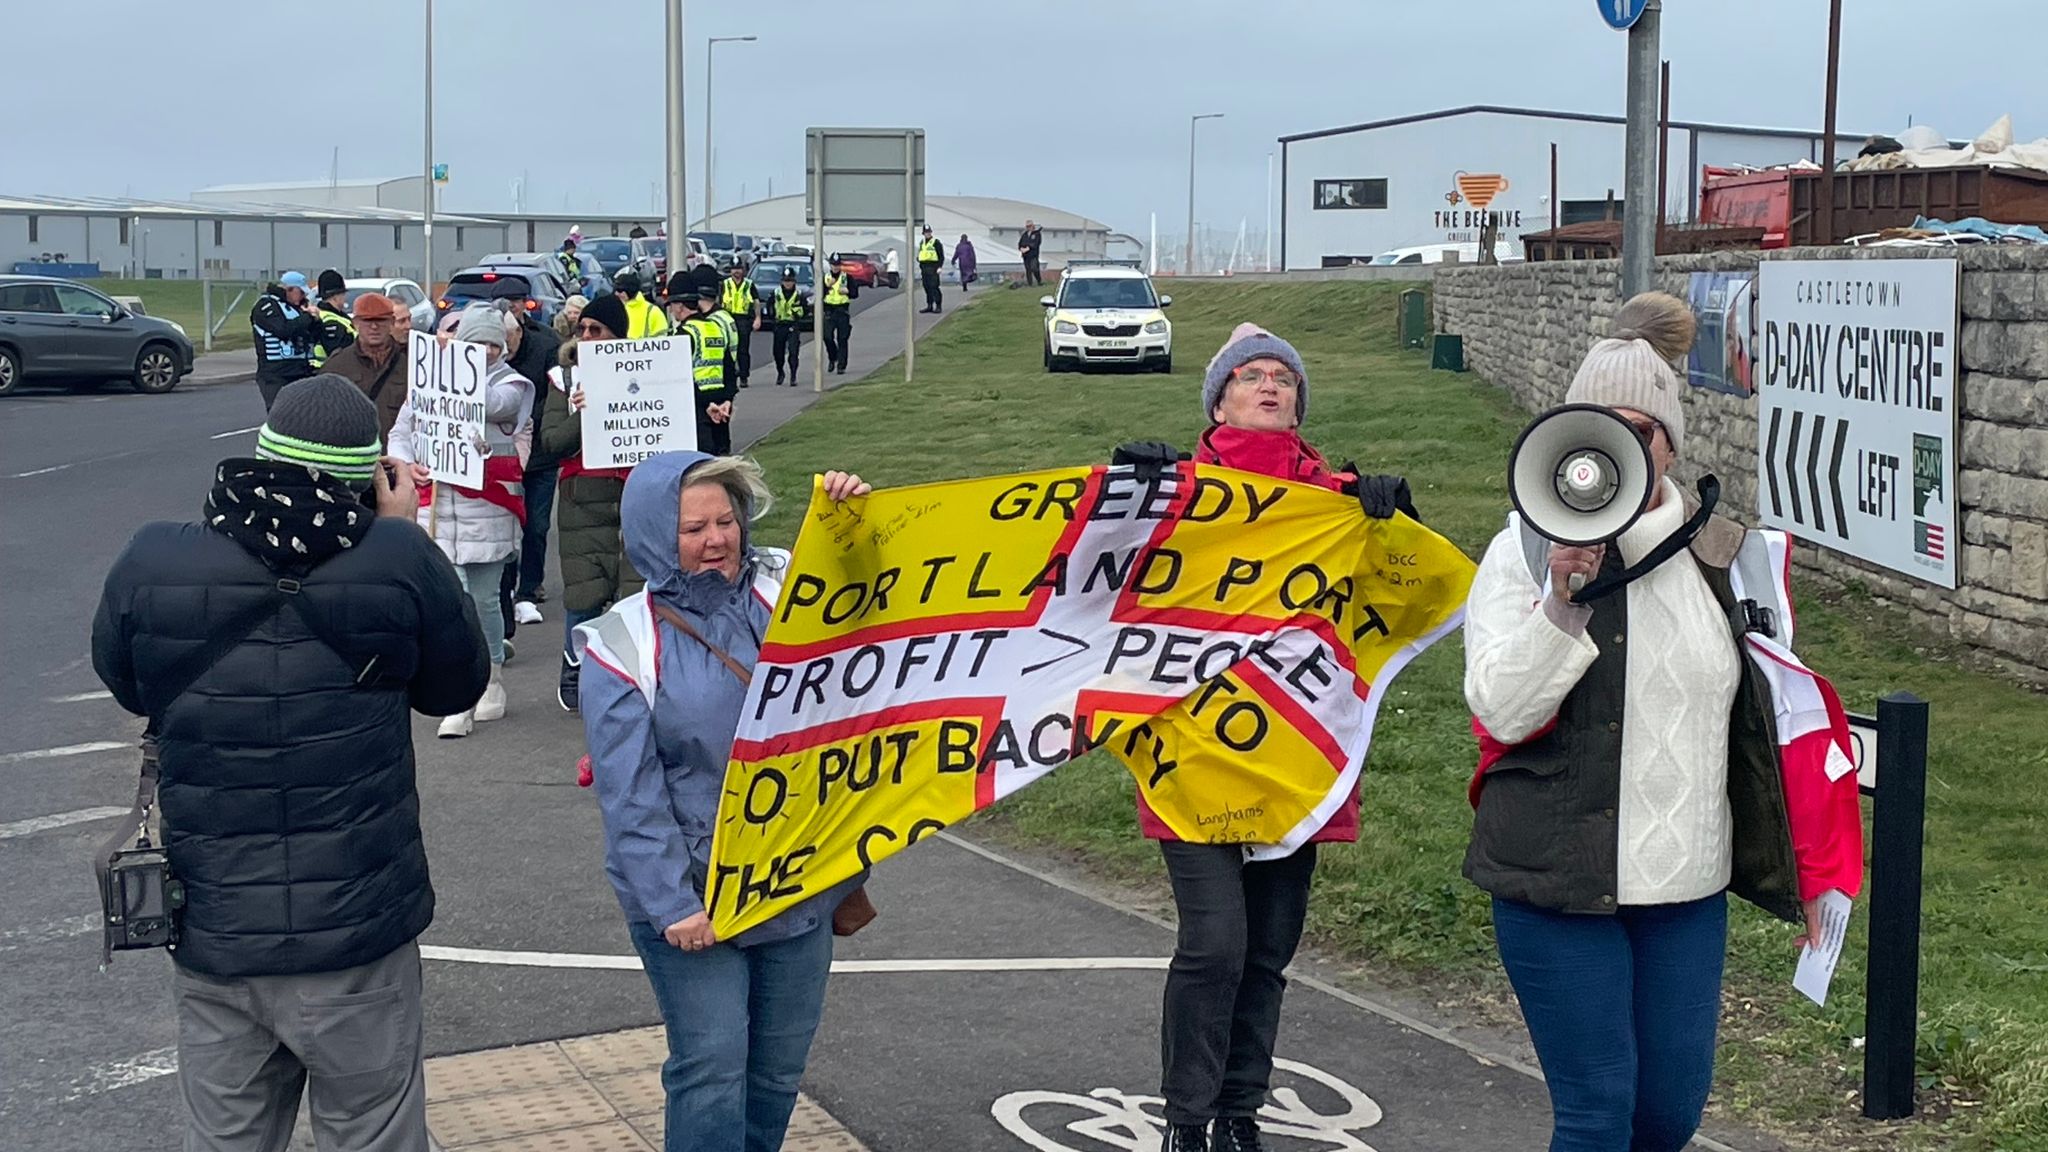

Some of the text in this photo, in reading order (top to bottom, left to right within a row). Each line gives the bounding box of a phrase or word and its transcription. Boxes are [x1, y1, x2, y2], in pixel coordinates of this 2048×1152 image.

[1435, 210, 1521, 228] THE BEEIVE
[1797, 281, 1900, 307] CASTLETOWN
[595, 340, 671, 355] PORTLAND
[415, 333, 478, 397] BILLS
[615, 359, 653, 372] PORT
[1765, 320, 1944, 412] D-DAY CENTRE
[412, 388, 484, 424] BANK ACCOUNT
[608, 400, 664, 413] MAKING
[447, 422, 463, 440] BE
[604, 416, 670, 431] MILLIONS
[611, 434, 663, 447] OUT OF
[1914, 448, 1942, 479] D-DAY
[989, 472, 1288, 524] GREEDY
[1858, 449, 1899, 521] LEFT
[780, 547, 1390, 643] PORTLAND PORT
[755, 630, 1008, 720] PROFIT
[818, 730, 919, 805] PUT
[707, 845, 818, 921] THE
